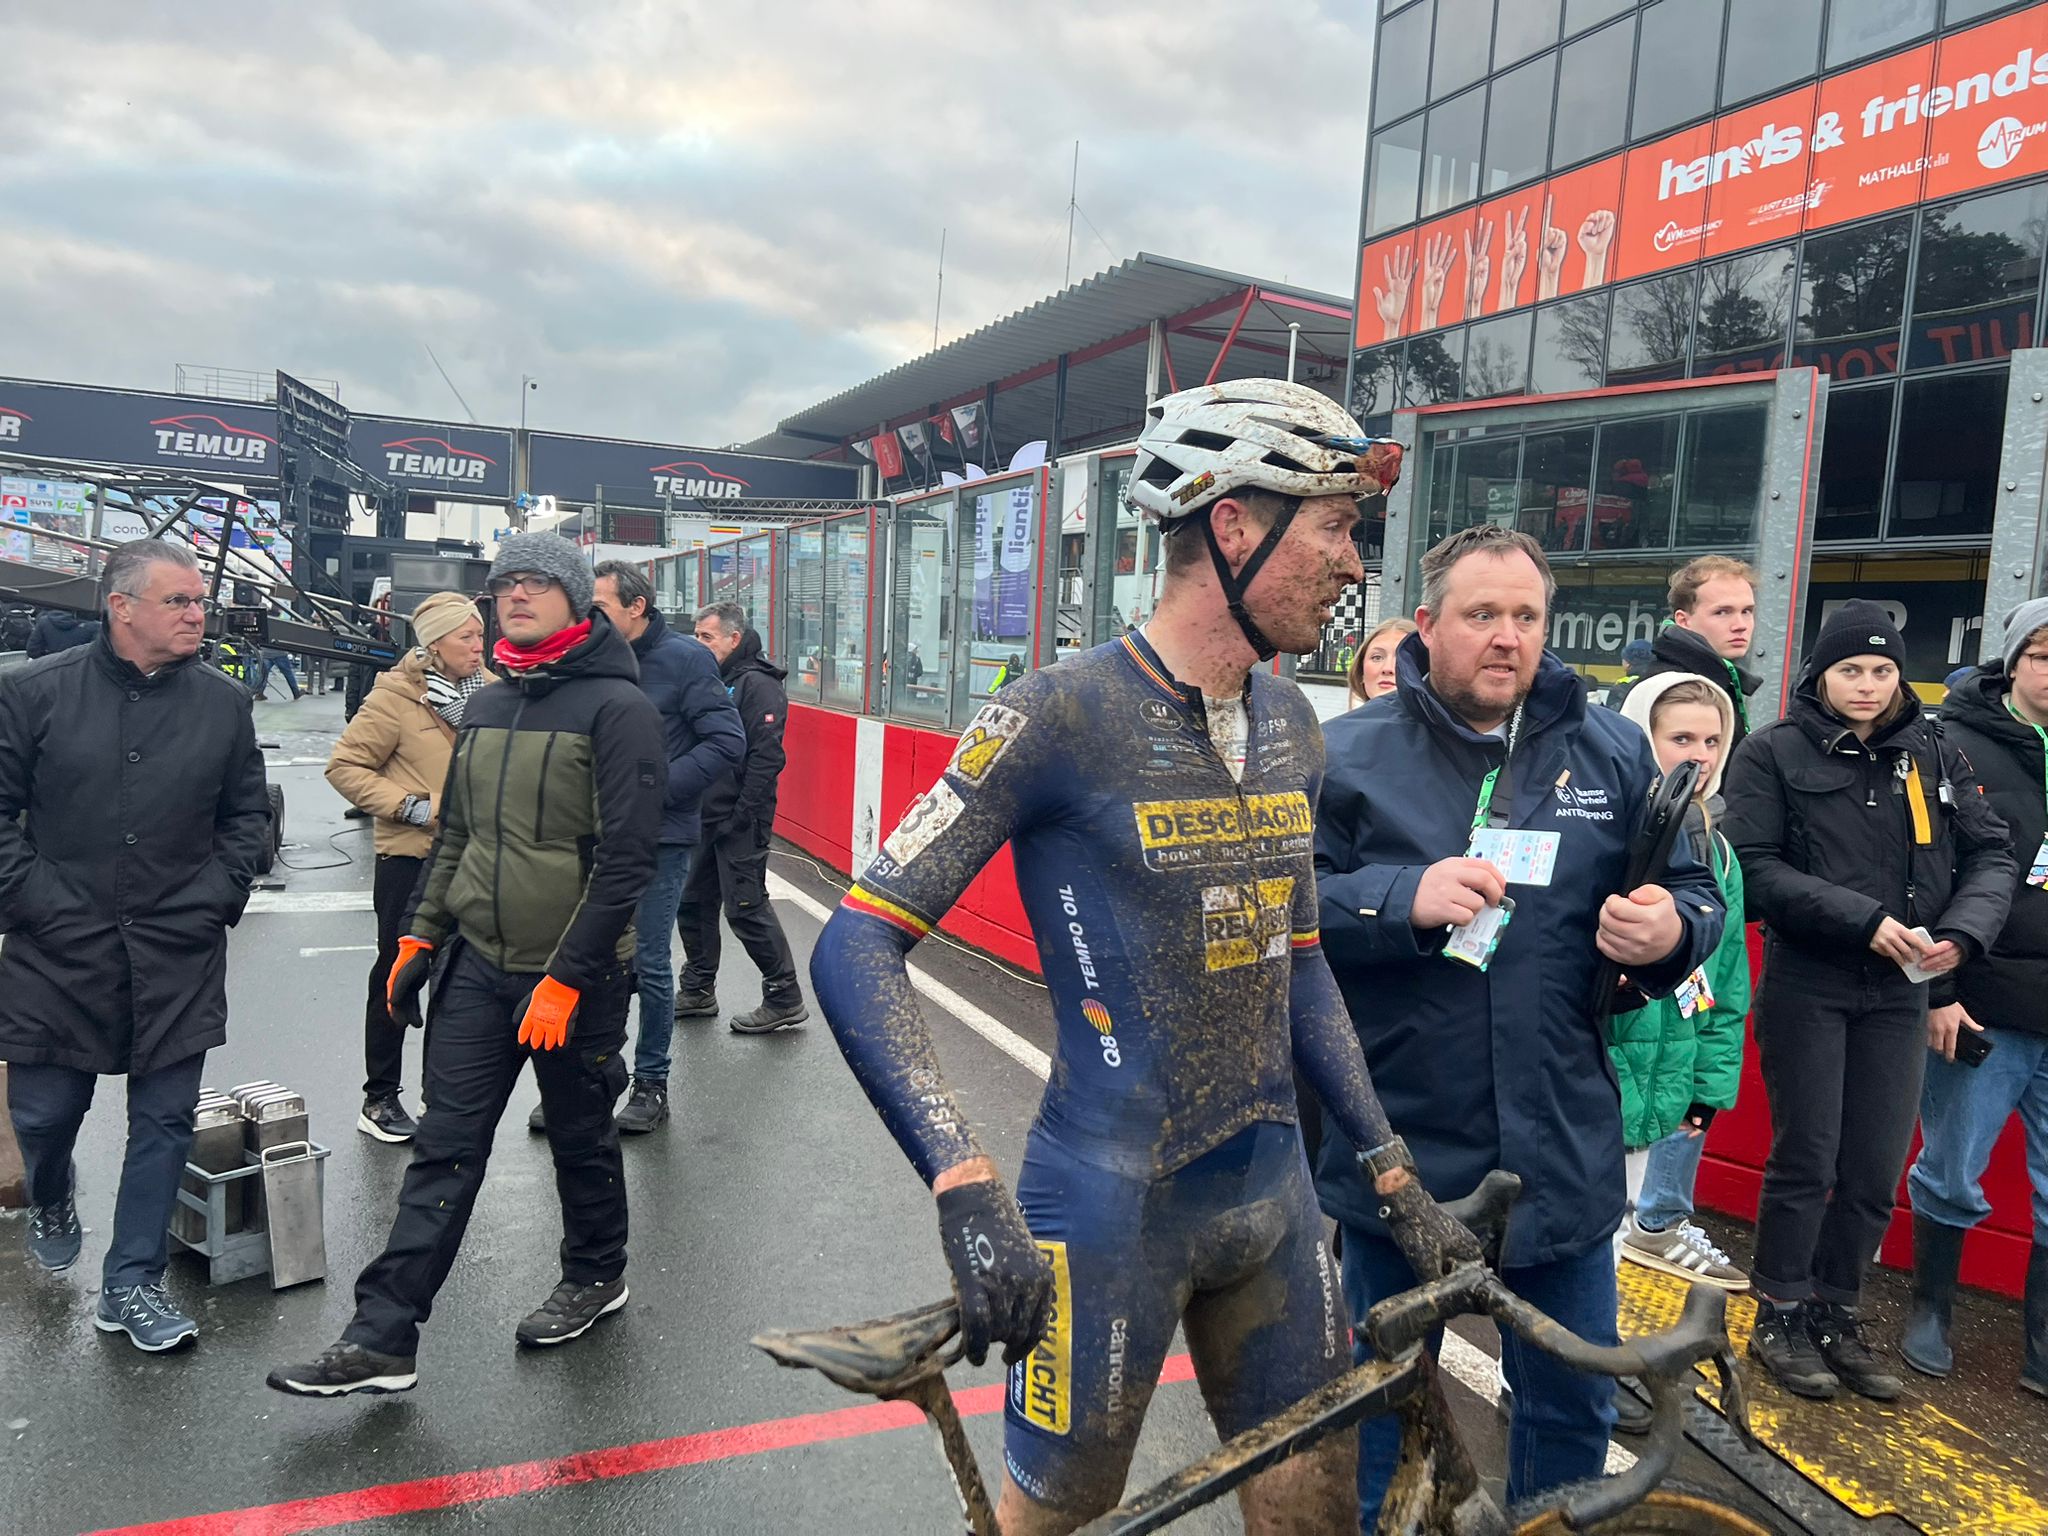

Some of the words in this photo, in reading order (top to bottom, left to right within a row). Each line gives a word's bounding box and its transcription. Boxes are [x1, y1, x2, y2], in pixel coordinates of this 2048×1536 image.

[1658, 123, 1803, 201] hands
[1811, 112, 1845, 153] &
[1861, 48, 2048, 138] friends
[1858, 155, 1932, 187] MATHALEX
[155, 429, 267, 459] TEMUR
[386, 451, 486, 479] TEMUR
[30, 499, 53, 507] SUYS
[653, 475, 742, 499] TEMUR
[335, 640, 367, 653] eurogrip
[871, 855, 904, 879] FSP
[1058, 884, 1079, 917] OIL
[1068, 921, 1100, 990] TEMPO
[1100, 1034, 1122, 1068] Q8
[962, 1226, 980, 1277] OAKLEY
[1315, 1240, 1336, 1359] cannondale
